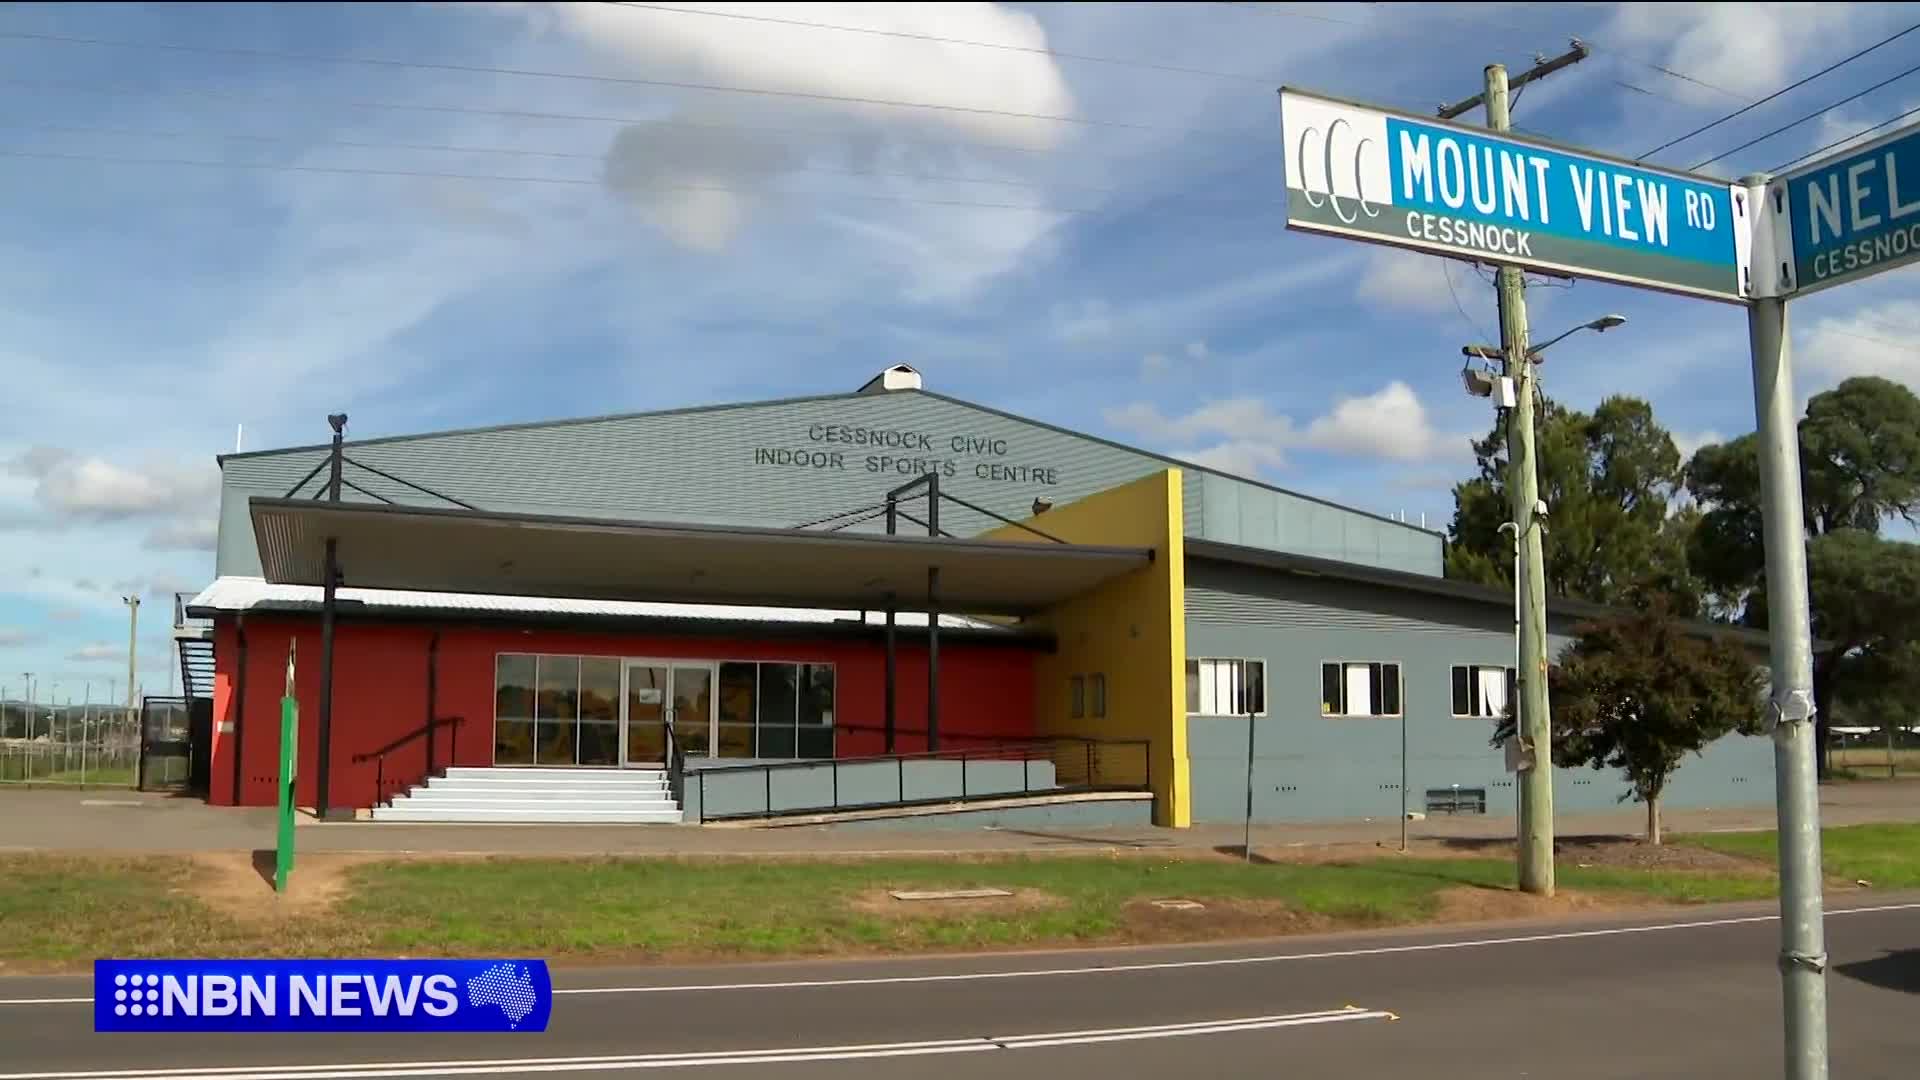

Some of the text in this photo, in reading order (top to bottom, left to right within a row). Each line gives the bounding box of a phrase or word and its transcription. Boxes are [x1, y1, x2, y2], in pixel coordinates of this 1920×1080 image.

[1400, 130, 1716, 248] MOUNT VIEW RD
[1808, 152, 1920, 245] NEL
[1406, 211, 1532, 257] CESSNOCK
[809, 424, 1007, 456] CESSNOCK CIVIC
[755, 447, 1057, 485] INDOOR SPORTS CENTRE
